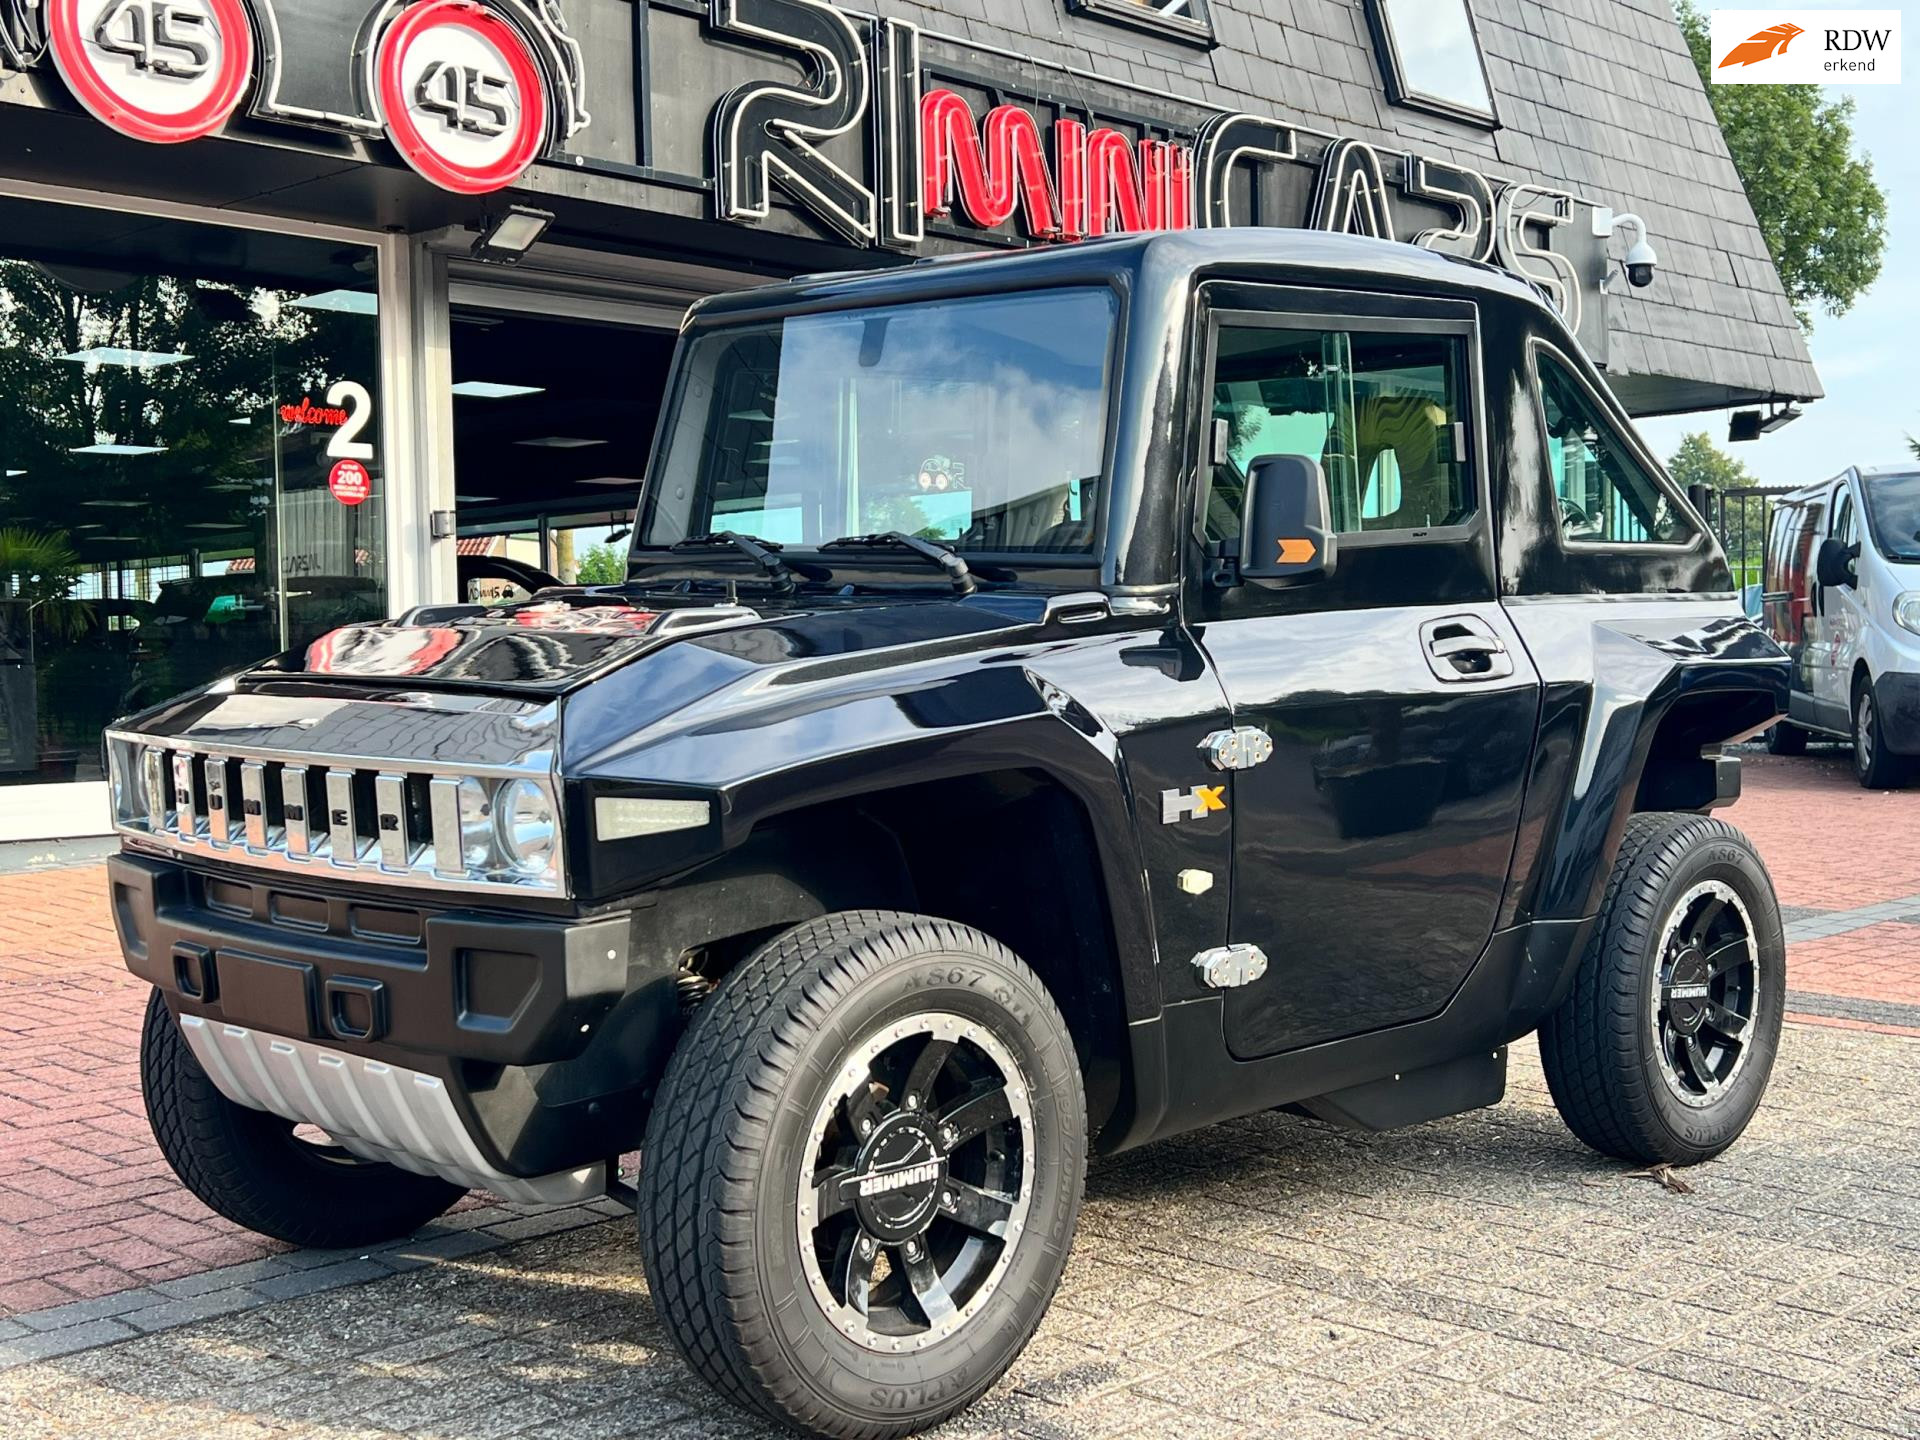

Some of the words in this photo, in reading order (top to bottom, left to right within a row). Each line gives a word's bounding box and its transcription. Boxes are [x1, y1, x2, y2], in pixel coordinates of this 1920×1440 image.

[94, 0, 217, 78] 45
[415, 60, 515, 137] 45
[278, 397, 348, 426] welcome
[326, 380, 373, 459] 2
[337, 470, 363, 485] 200
[175, 788, 399, 831] HUMMER
[1161, 784, 1226, 825] HX
[1670, 986, 1708, 999] HUMMER
[860, 1163, 939, 1197] HUMMER
